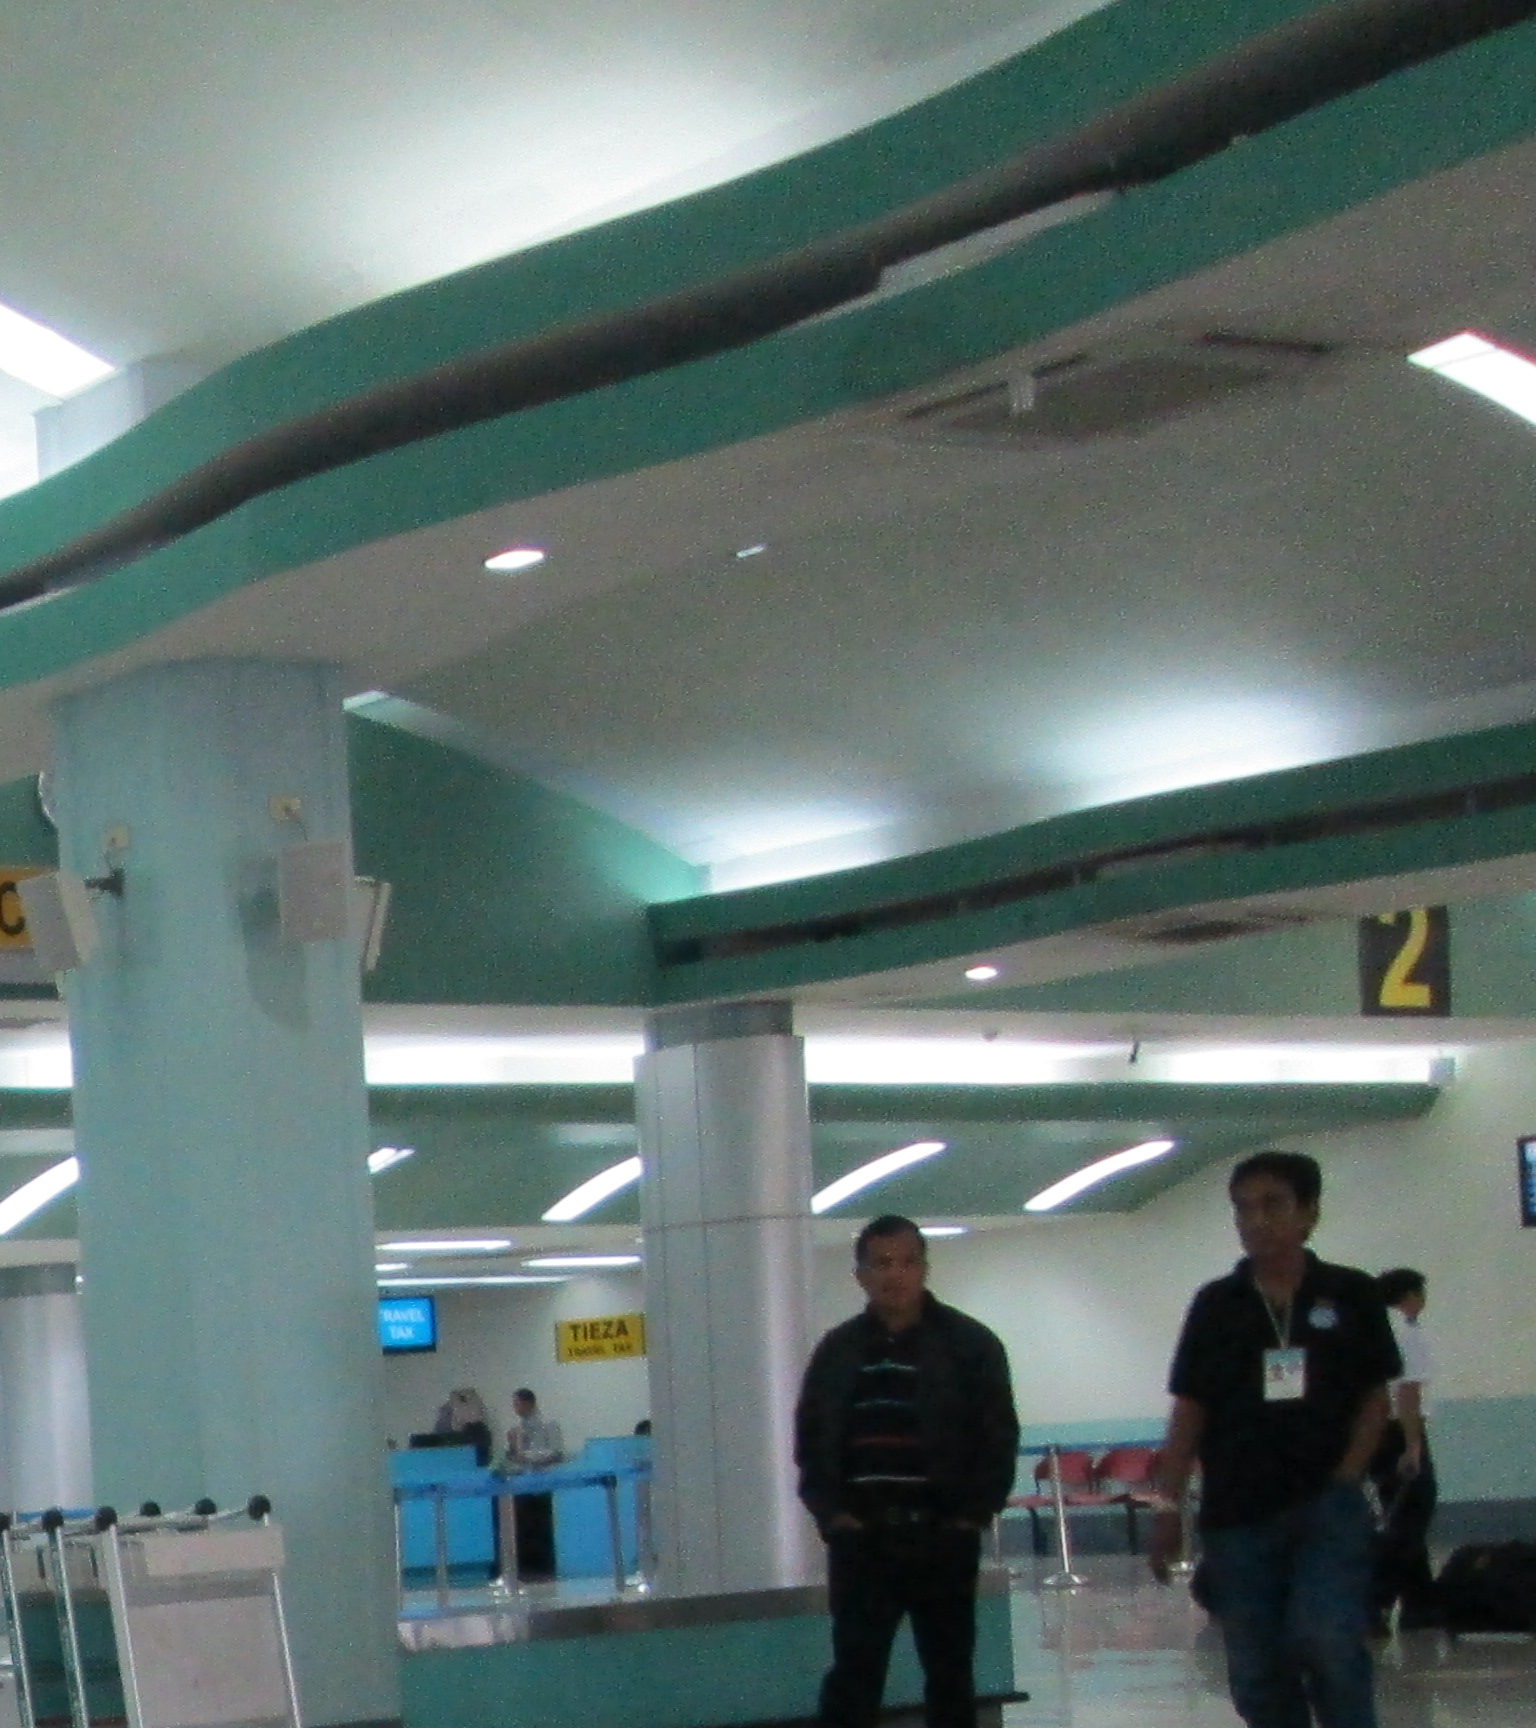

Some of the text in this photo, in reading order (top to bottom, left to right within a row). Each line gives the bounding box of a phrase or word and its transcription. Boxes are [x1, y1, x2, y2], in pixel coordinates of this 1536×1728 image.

[1378, 909, 1430, 1008] 2
[380, 1308, 425, 1323] RAVEL
[569, 1319, 629, 1341] TIEZA
